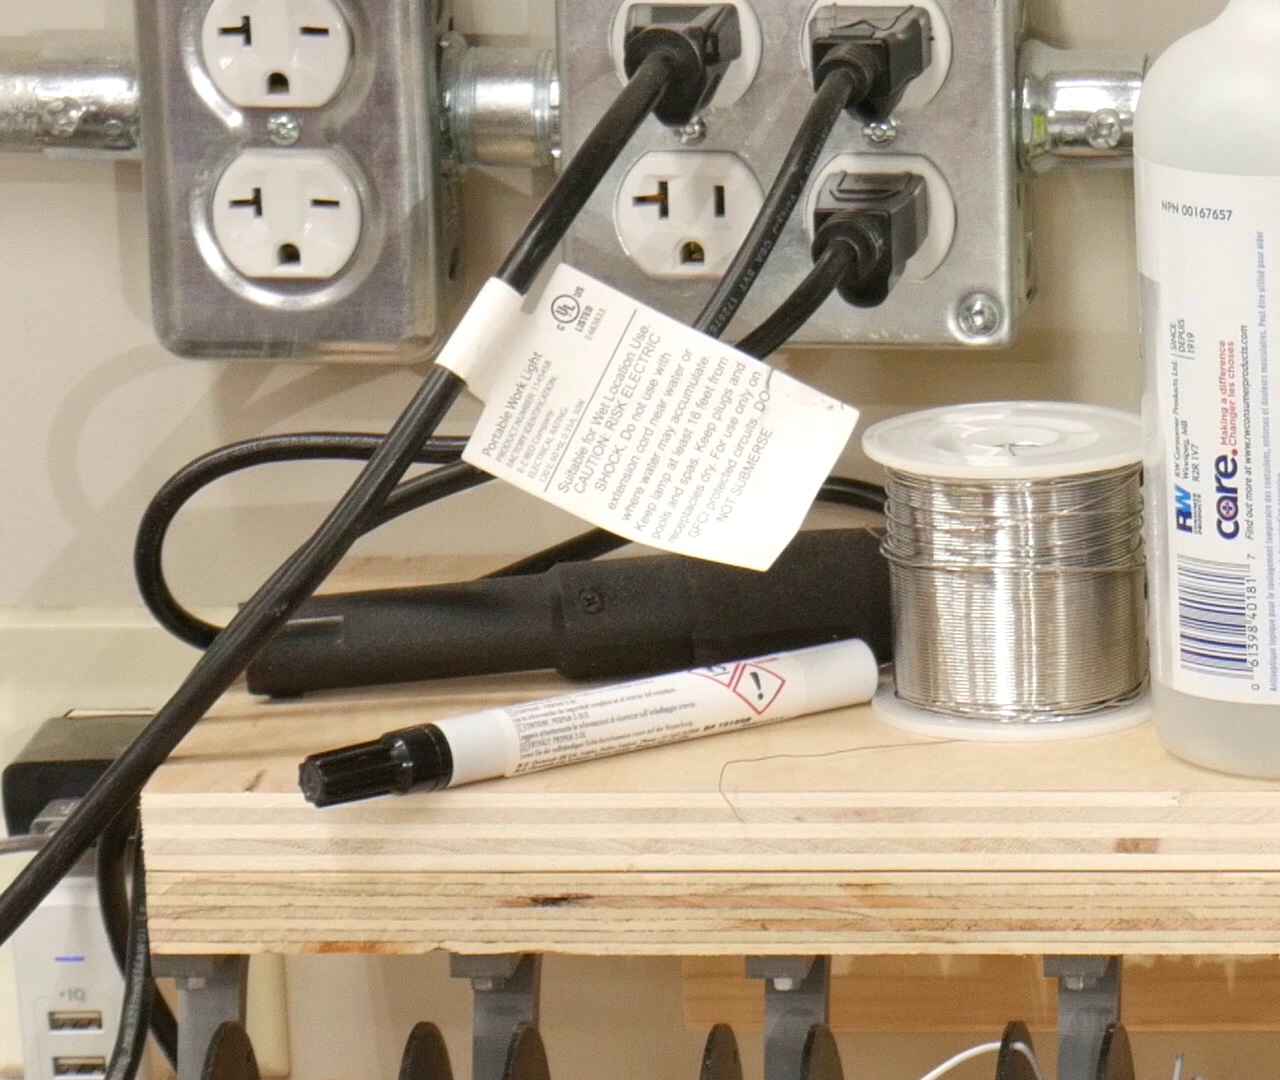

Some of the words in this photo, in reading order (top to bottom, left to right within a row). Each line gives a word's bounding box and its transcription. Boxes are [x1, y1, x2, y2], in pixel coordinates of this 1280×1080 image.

[1161, 200, 1180, 215] NPN
[1181, 204, 1233, 221] 00167657
[739, 268, 757, 291] SVT
[573, 304, 594, 332] LISTED
[1177, 318, 1185, 352] DEPUIS
[1169, 321, 1177, 350] SINCE
[1186, 332, 1194, 353] 1919
[707, 355, 730, 385] from
[1170, 360, 1178, 376] Ltd.
[1217, 340, 1227, 394] difference
[1225, 341, 1234, 376] choses
[481, 410, 513, 457] Portable
[504, 380, 528, 412] Work
[519, 350, 545, 383] Light
[619, 421, 636, 441] Do
[628, 400, 647, 422] not
[640, 377, 659, 401] use
[651, 350, 672, 377] with
[666, 351, 713, 424] accumulate.
[694, 384, 715, 410] feet
[1171, 378, 1179, 415] Products
[1227, 379, 1235, 397] les
[1239, 324, 1252, 464] www.rwconsumerproducts.com
[504, 433, 529, 469] FACTORY
[521, 374, 560, 434] IDENTIFICATION:
[556, 444, 590, 494] Suitable
[580, 426, 597, 445] for
[589, 401, 611, 427] Wet
[601, 350, 637, 402] Location
[628, 320, 651, 351] Use.
[571, 431, 613, 495] CAUTION:
[603, 398, 627, 431] RISK
[618, 331, 662, 399] ELECTRIC
[686, 409, 702, 426] 16
[1227, 400, 1237, 446] Changer
[522, 443, 537, 460] RED
[530, 408, 556, 446] Company
[604, 453, 642, 511] extension
[632, 426, 654, 454] cord
[647, 398, 669, 427] near
[661, 363, 686, 398] water
[680, 348, 694, 363] or
[655, 424, 678, 453] may
[670, 426, 694, 458] least
[1172, 417, 1180, 459] Consumer
[1180, 420, 1188, 435] MB
[1219, 407, 1228, 445] Making
[494, 424, 520, 463] PRODUCT
[526, 434, 555, 479] ELECTRICAL
[649, 508, 674, 541] pools
[664, 484, 684, 509] and
[678, 454, 702, 487] spas.
[693, 420, 718, 454] Keep
[709, 386, 736, 421] plugs
[726, 360, 747, 386] and
[666, 482, 707, 546] receptacles
[698, 460, 719, 484] dry.
[709, 438, 728, 460] For
[721, 415, 739, 438] use
[731, 387, 755, 416] only
[746, 369, 762, 388] on
[1181, 438, 1190, 479] Winnipeg,
[1190, 443, 1199, 460] 1V7
[638, 451, 662, 485] water
[665, 456, 679, 471] at
[687, 509, 711, 540] GFCI
[703, 458, 740, 511] protected
[729, 415, 760, 459] circuits.
[753, 389, 772, 412] DO
[1173, 461, 1180, 477] RW
[1191, 462, 1200, 482] R2R
[1243, 466, 1251, 476] at
[619, 484, 646, 522] where
[649, 470, 674, 502] lamp
[633, 500, 659, 533] Keep
[715, 496, 737, 524] NOT
[1173, 482, 1192, 533] RW
[1244, 501, 1253, 517] out
[1244, 519, 1254, 540] Find
[1246, 578, 1257, 619] 40181
[1247, 625, 1258, 667] 61398
